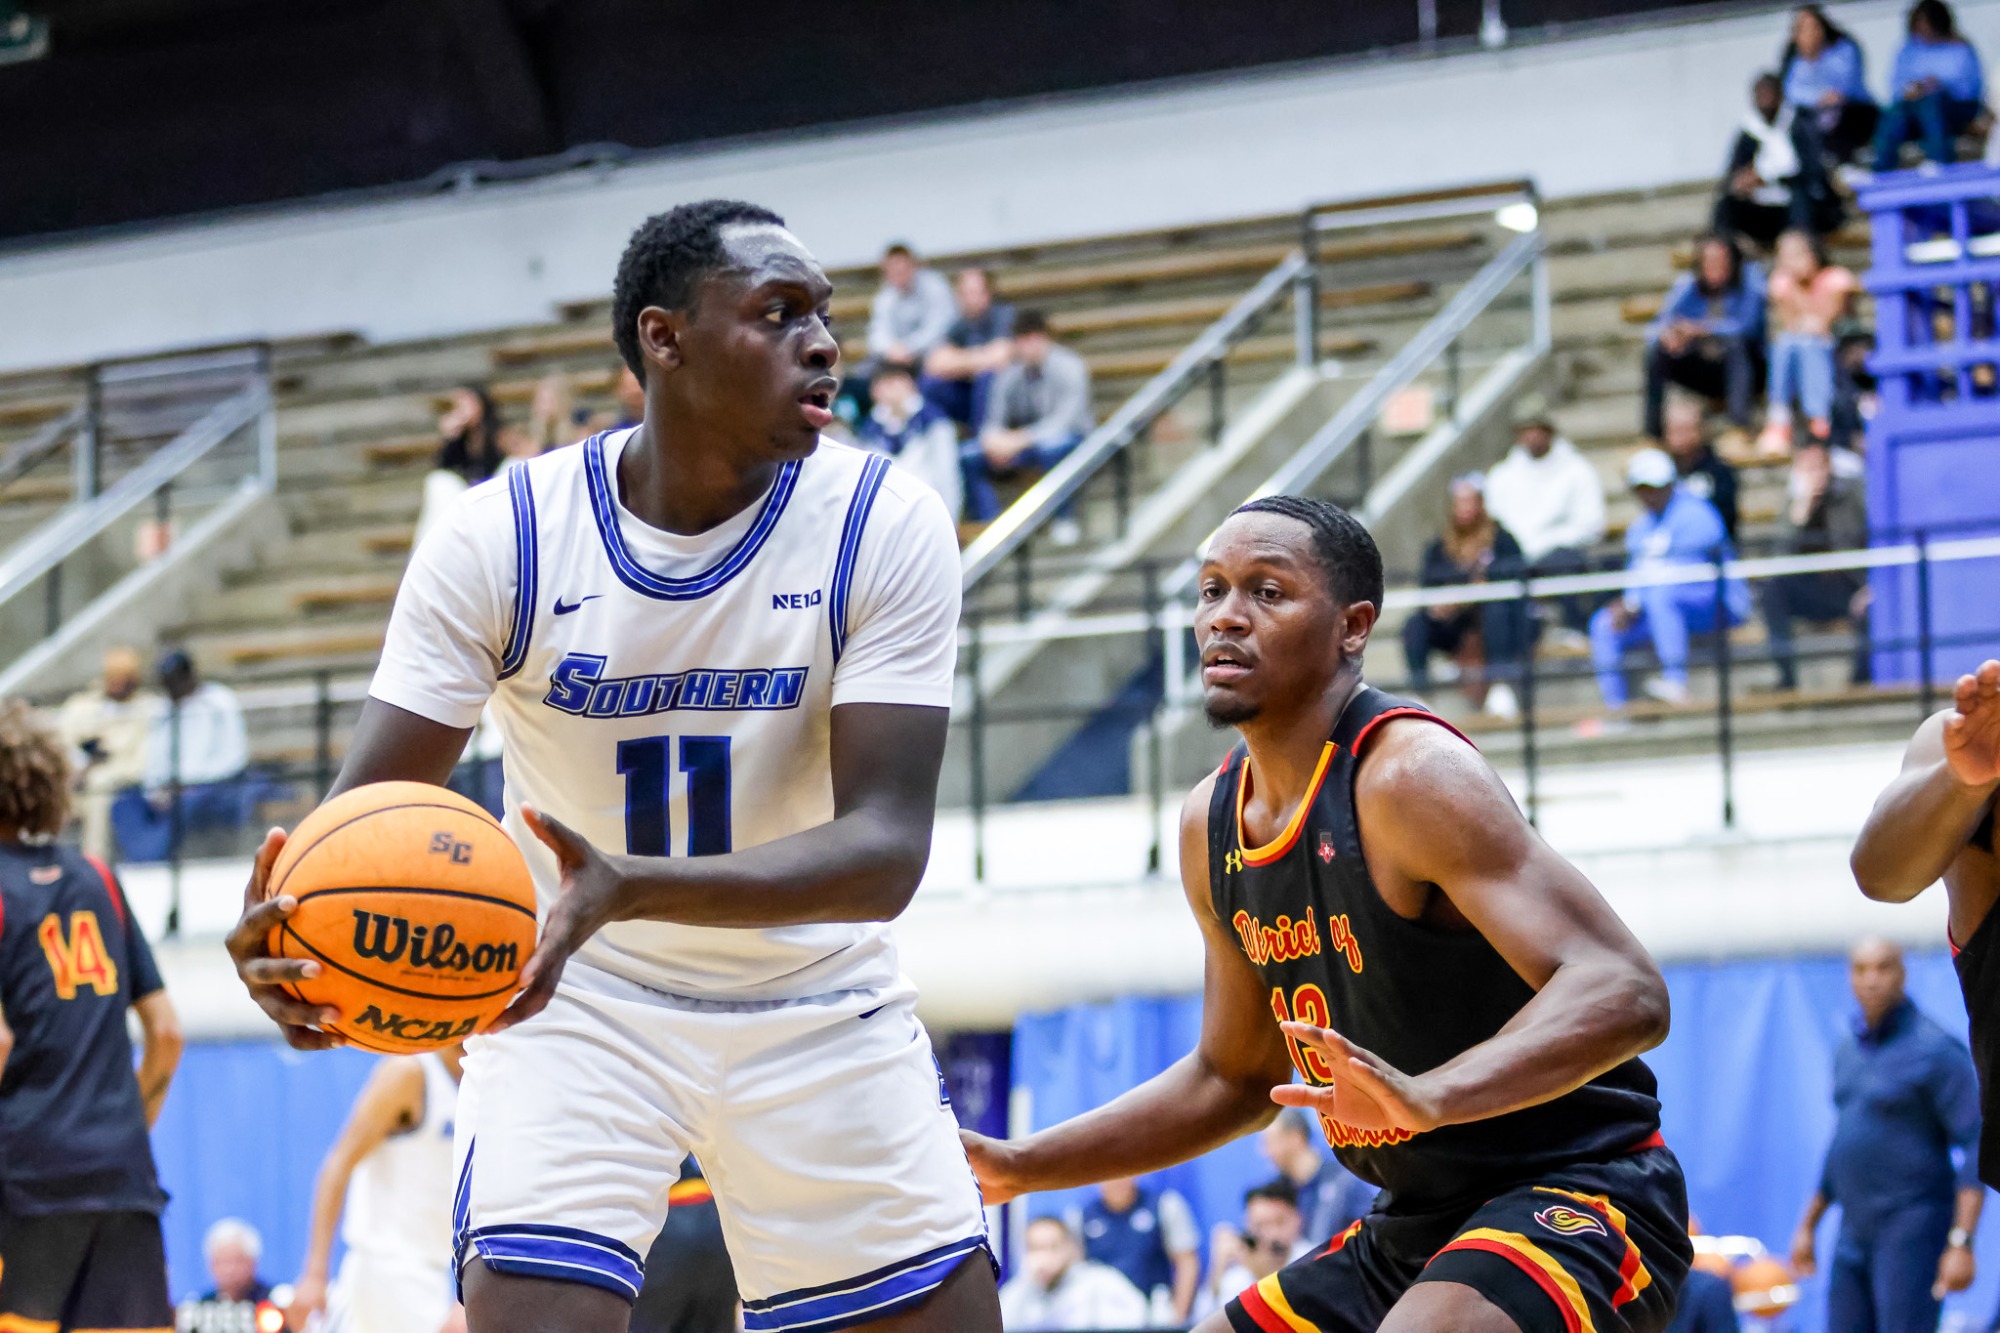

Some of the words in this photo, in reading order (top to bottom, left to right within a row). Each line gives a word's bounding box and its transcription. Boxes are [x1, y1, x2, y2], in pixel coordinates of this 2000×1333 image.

[772, 588, 822, 610] NE10
[542, 652, 809, 719] SOUTHERN
[616, 735, 732, 857] 11
[430, 831, 473, 865] SC
[38, 910, 118, 1000] 14
[353, 908, 518, 973] Wilson
[1329, 913, 1363, 974] of
[354, 1004, 479, 1041] NCAA
[1270, 983, 1334, 1084] 13
